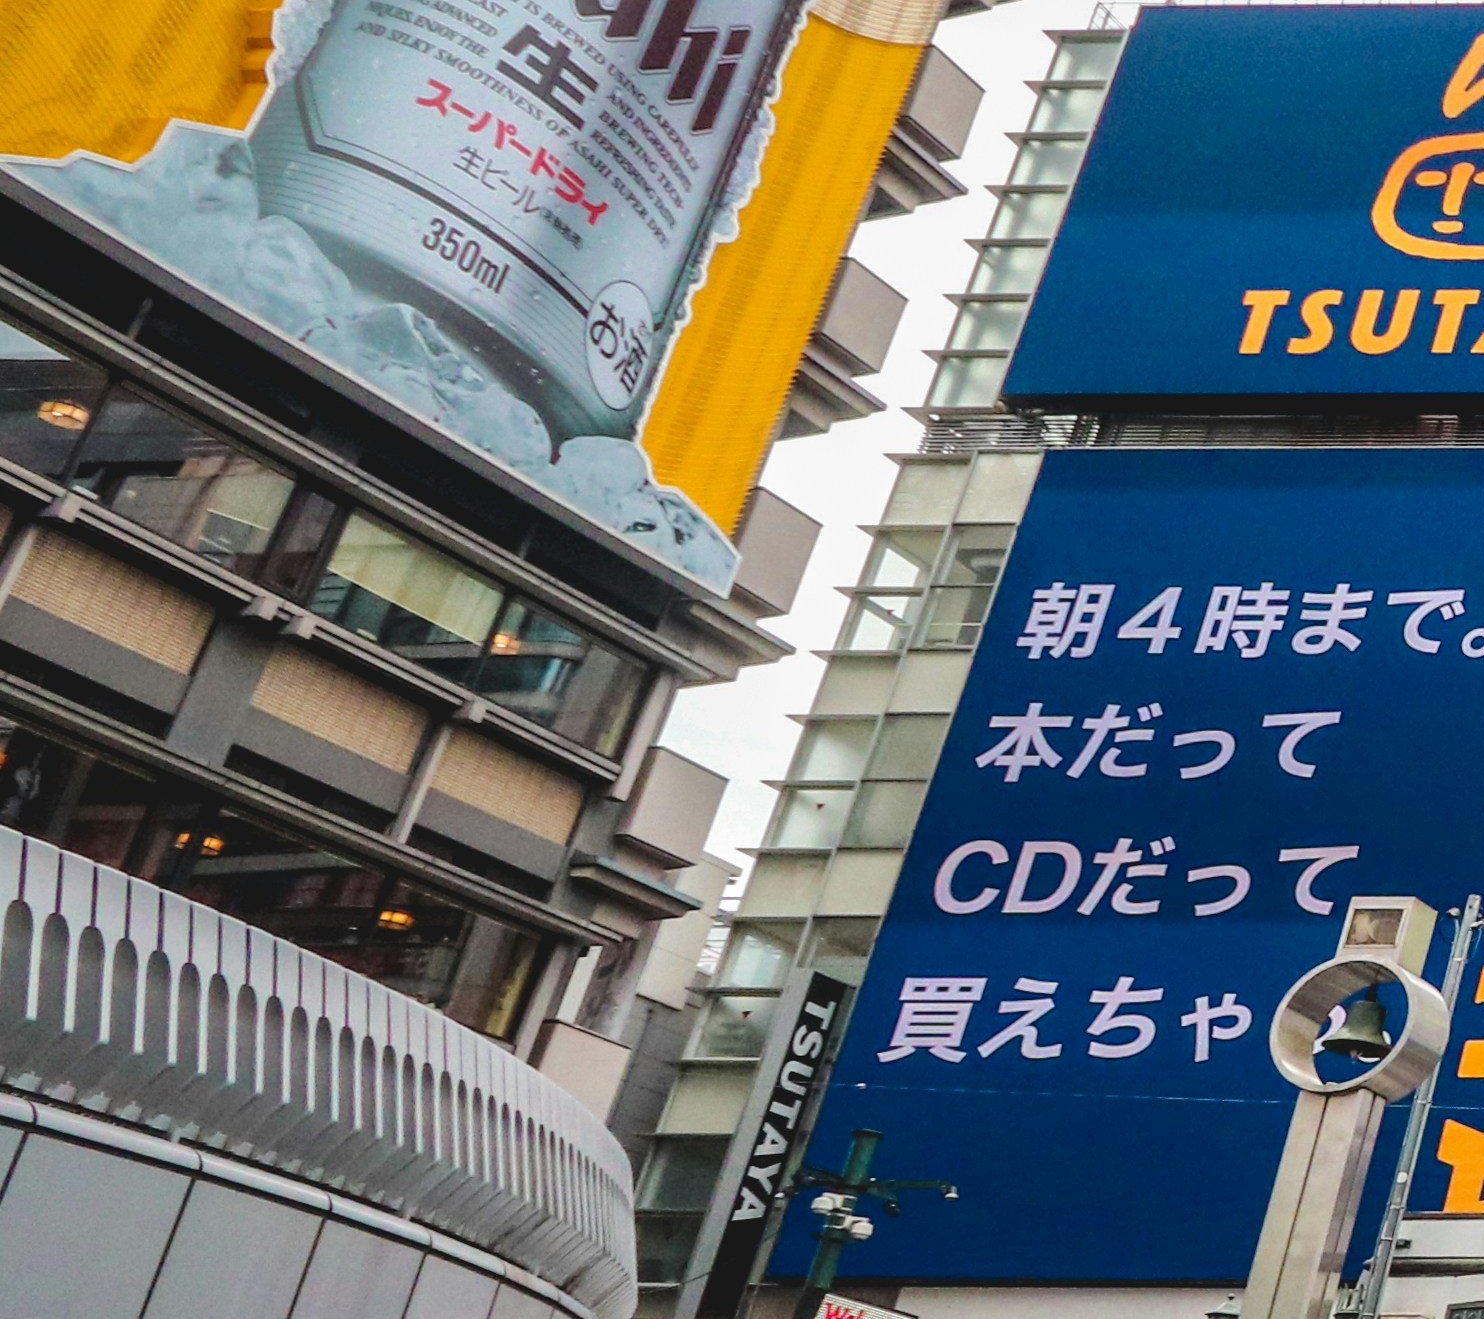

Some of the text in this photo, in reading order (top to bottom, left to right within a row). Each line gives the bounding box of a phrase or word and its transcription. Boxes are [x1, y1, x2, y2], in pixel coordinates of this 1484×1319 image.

[495, 22, 601, 133] 生
[415, 77, 610, 227] スーパードライ
[420, 216, 511, 295] 350ml
[974, 701, 1345, 784] 本だって
[931, 835, 1362, 920] CDだって
[731, 999, 838, 1223] TSUTAYA
